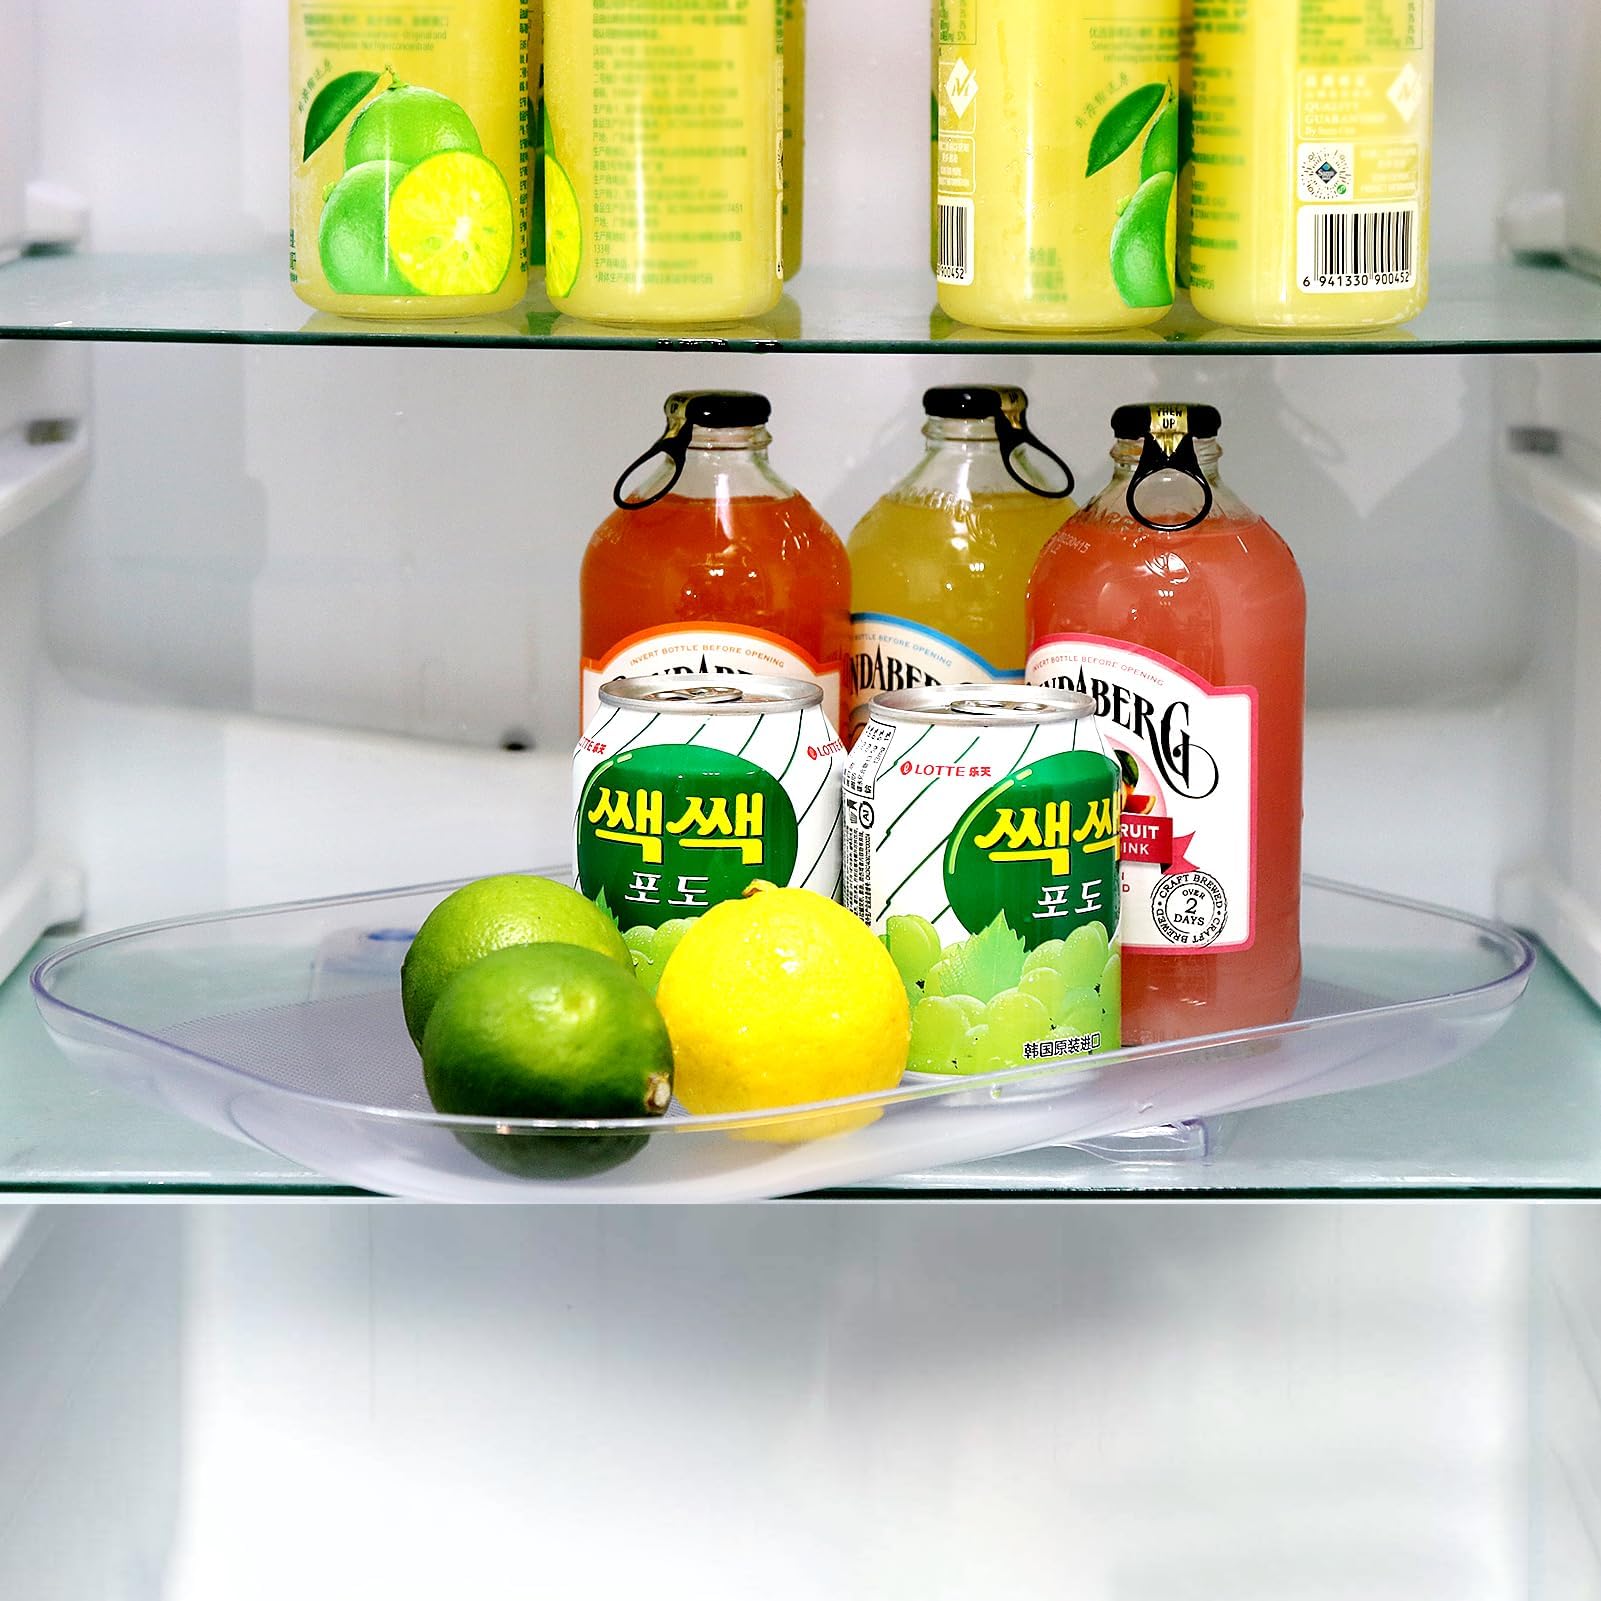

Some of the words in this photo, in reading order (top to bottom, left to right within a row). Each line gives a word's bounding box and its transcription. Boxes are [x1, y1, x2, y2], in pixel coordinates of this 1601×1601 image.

[1303, 276, 1310, 287] 6
[1319, 274, 1369, 287] 941330
[1374, 272, 1410, 286] 900452
[1162, 418, 1176, 429] UP
[630, 651, 659, 667] INVERT
[661, 644, 699, 655] BOTTLE
[702, 645, 742, 655] BEFORE
[745, 649, 785, 668] OPENING
[878, 634, 910, 648] BEFORE
[912, 643, 953, 667] OPENING
[1050, 655, 1079, 664] BOTTLE
[1081, 656, 1119, 669] BEFORE
[1120, 664, 1165, 686] OPENING
[914, 764, 965, 777] LOTTE
[968, 766, 992, 778] 乐天
[588, 787, 764, 865] 쌕쌕
[1120, 823, 1160, 840] RUIT
[1159, 874, 1190, 899] CRAFT
[1193, 873, 1223, 909] BREWED
[1182, 889, 1206, 900] OVER
[1184, 897, 1198, 915] 2
[1156, 908, 1189, 944] BREWED
[1173, 914, 1205, 927] DAYS
[1191, 917, 1221, 944] CRAFT
[1024, 1033, 1101, 1059] 韩国原装进口
